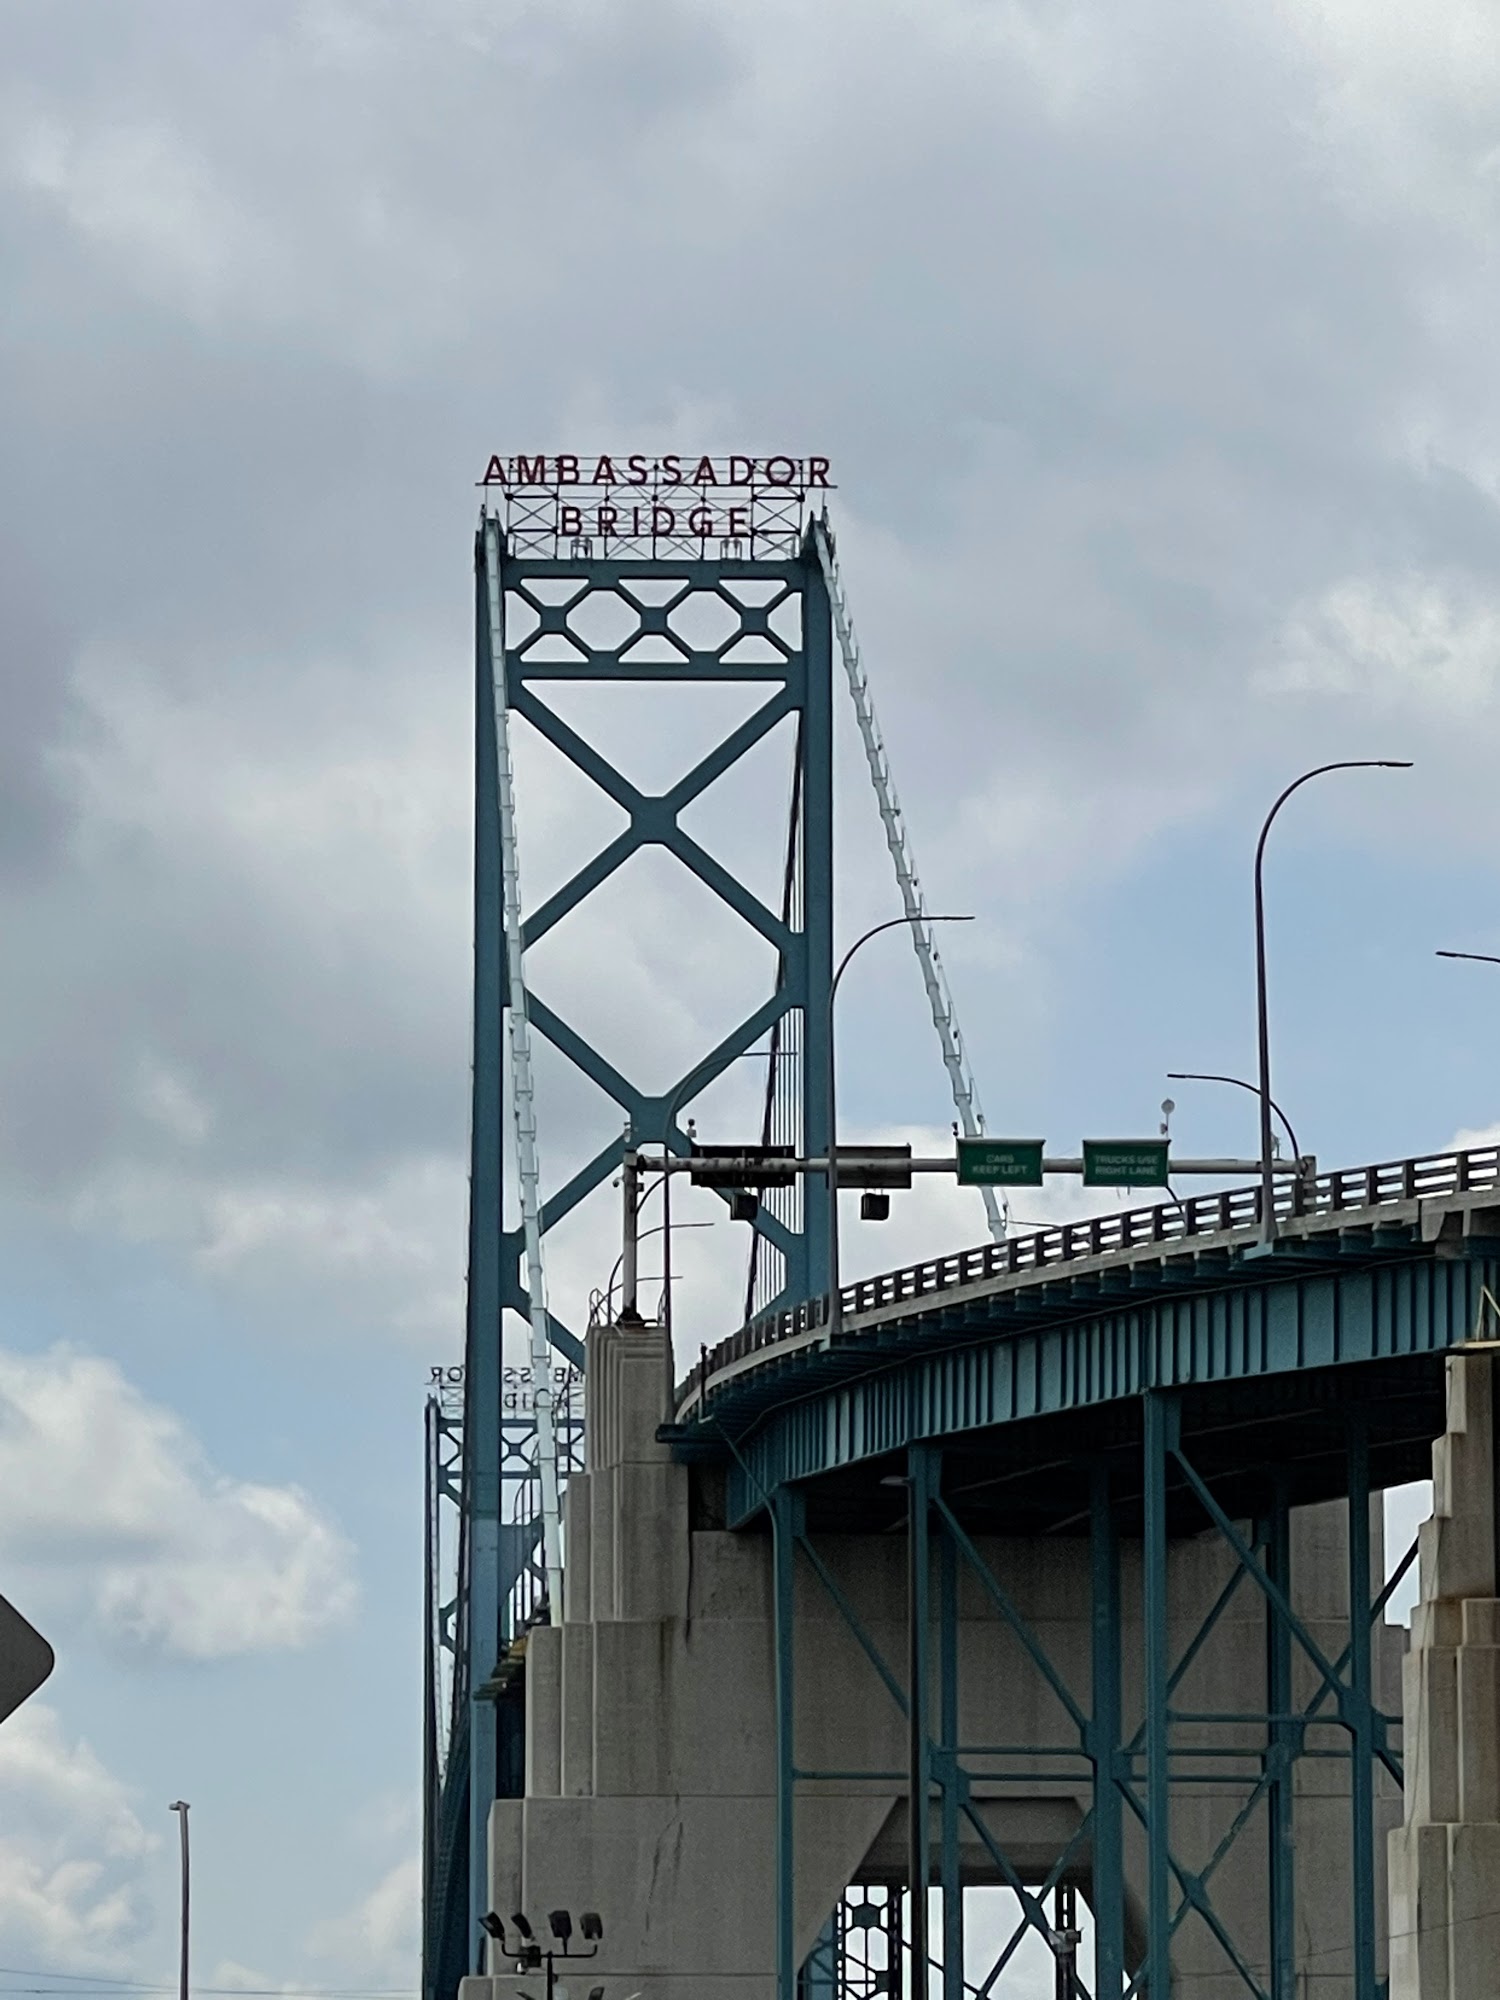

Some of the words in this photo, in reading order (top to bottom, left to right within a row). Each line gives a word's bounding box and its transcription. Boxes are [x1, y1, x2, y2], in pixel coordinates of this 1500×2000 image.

[483, 455, 831, 487] AMBASSADOR
[561, 506, 751, 537] BRIDGE
[986, 1154, 1014, 1164] CARS
[1094, 1154, 1136, 1165] TRUCKS
[1137, 1155, 1159, 1165] USE
[972, 1165, 999, 1175] KEEP
[1001, 1165, 1028, 1175] LEFT
[1095, 1165, 1127, 1176] RIGHT
[1128, 1166, 1158, 1176] LANE
